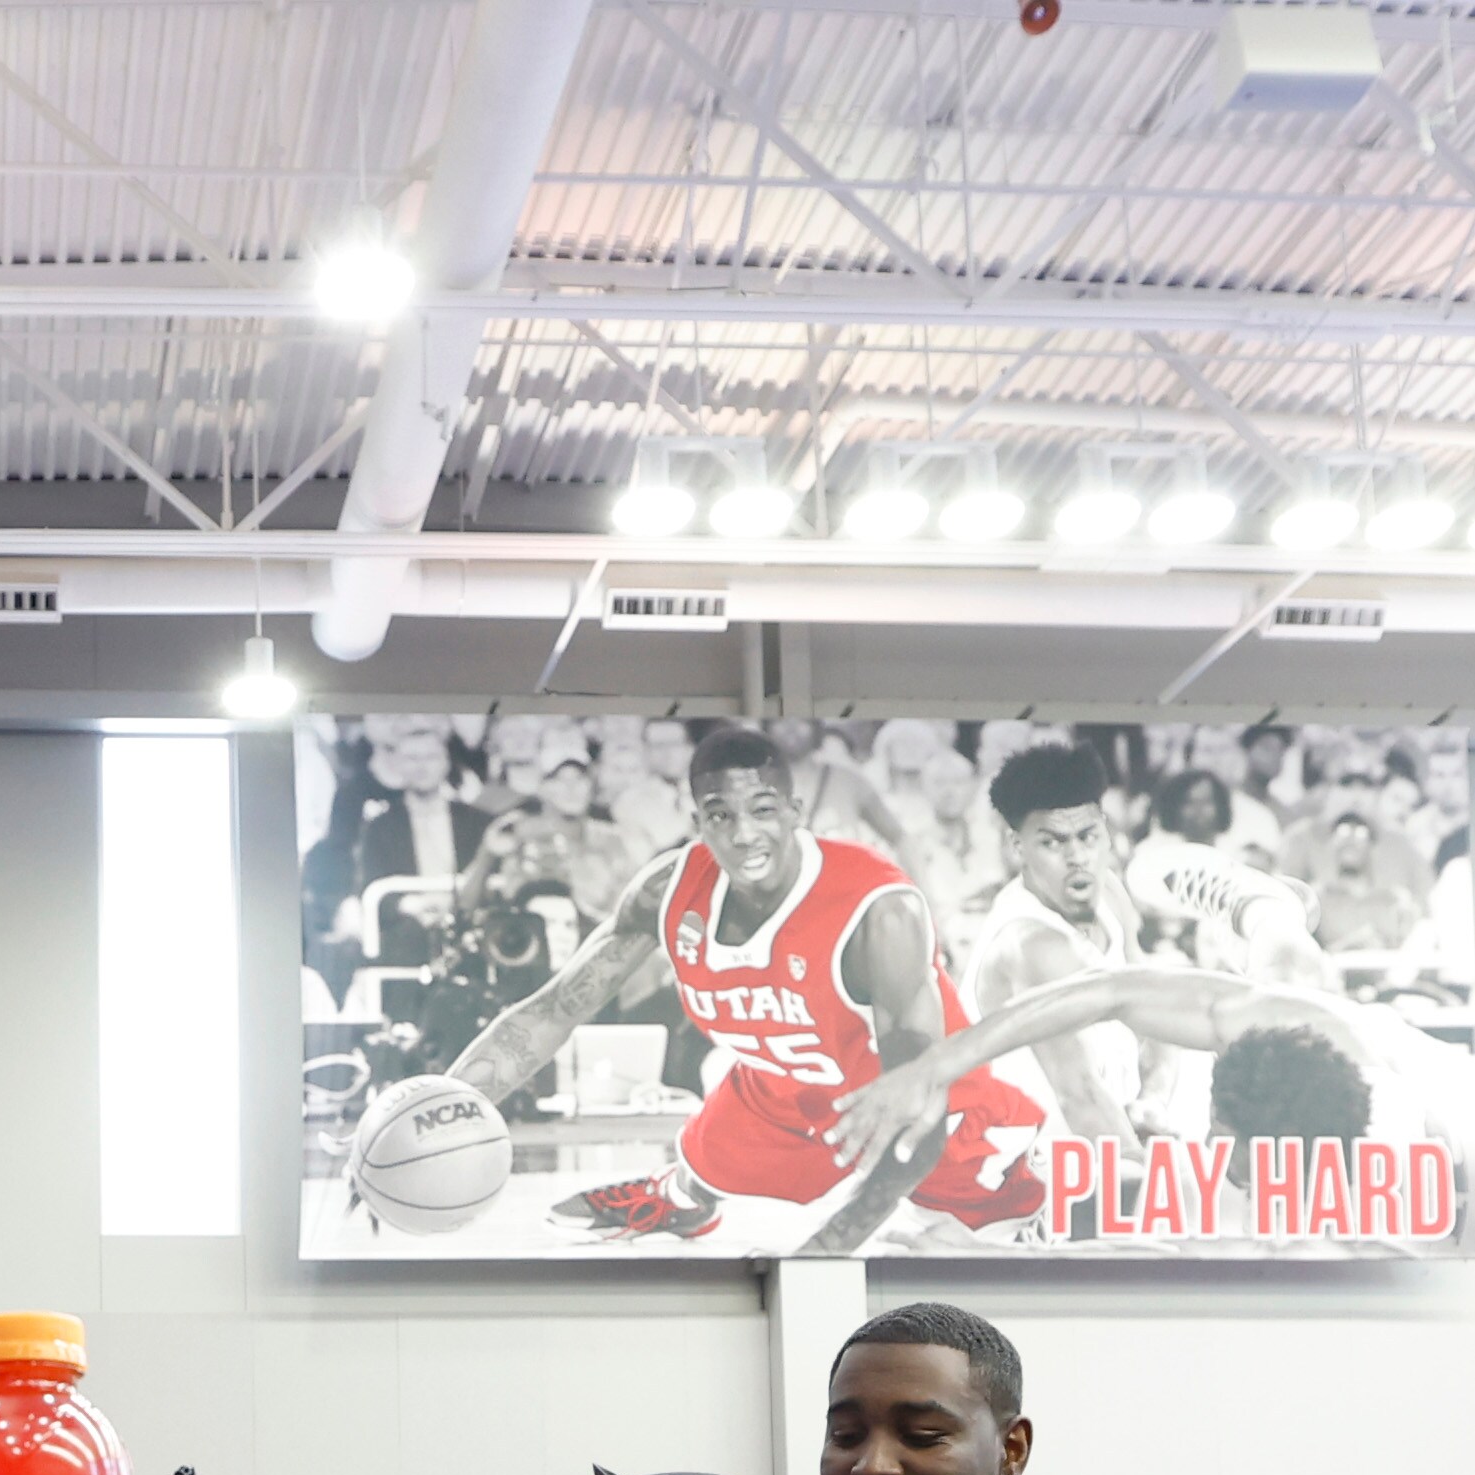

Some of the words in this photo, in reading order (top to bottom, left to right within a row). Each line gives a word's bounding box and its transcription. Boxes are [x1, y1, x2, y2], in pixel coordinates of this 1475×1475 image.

[683, 983, 816, 1026] UTAH
[707, 1028, 845, 1086] 55
[413, 1101, 484, 1135] NCAA
[1048, 1137, 1235, 1239] PLAY
[1252, 1137, 1456, 1240] HARD
